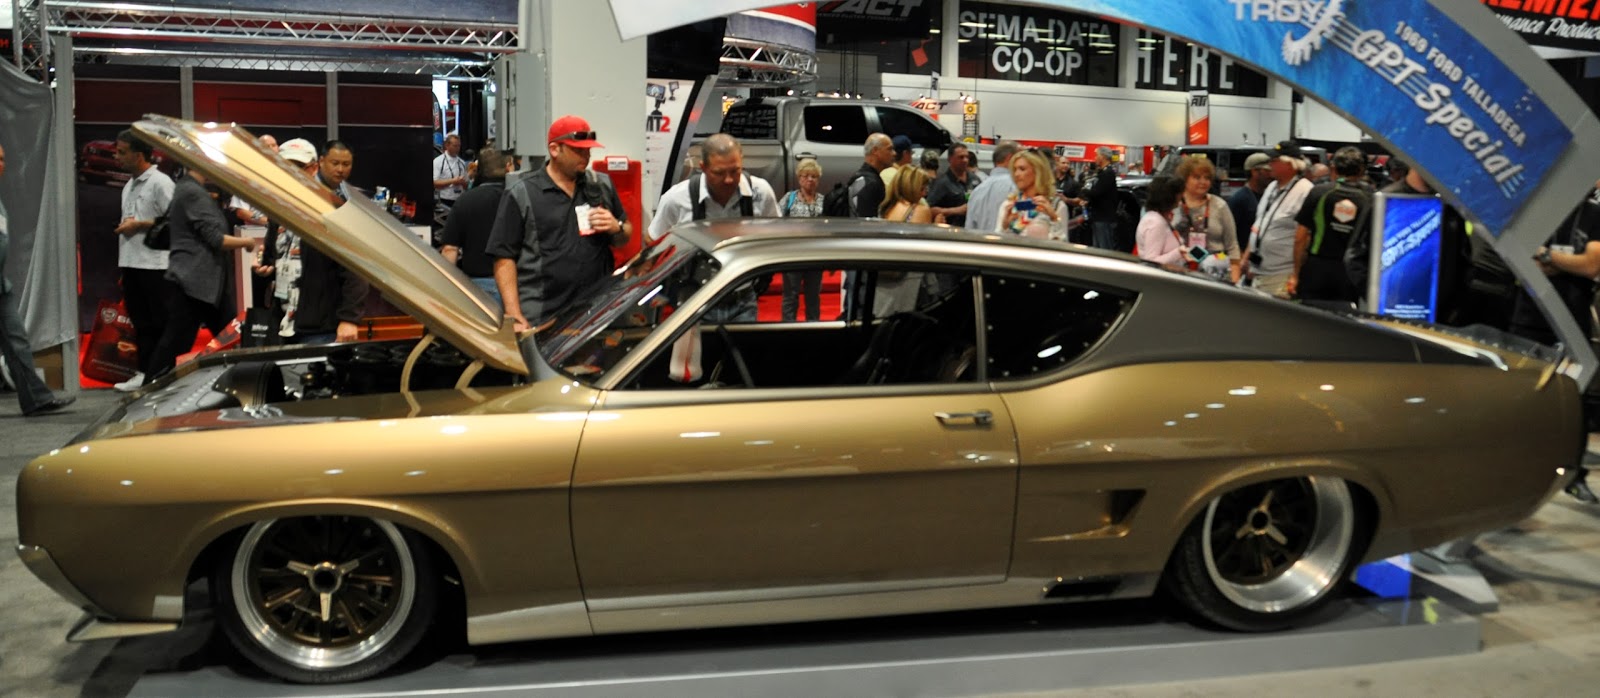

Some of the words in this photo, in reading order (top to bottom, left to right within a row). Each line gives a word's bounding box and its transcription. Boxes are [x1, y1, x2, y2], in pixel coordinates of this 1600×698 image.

[958, 10, 1041, 43] SEMA
[1047, 18, 1114, 48] DATA
[1228, 0, 1325, 23] TROY
[991, 46, 1083, 77] CO-OP
[1394, 20, 1429, 53] 1969
[1426, 47, 1463, 83] FORD
[1461, 76, 1527, 147] TALLADEGA
[1351, 29, 1427, 86] GPT
[1414, 82, 1524, 183] Special
